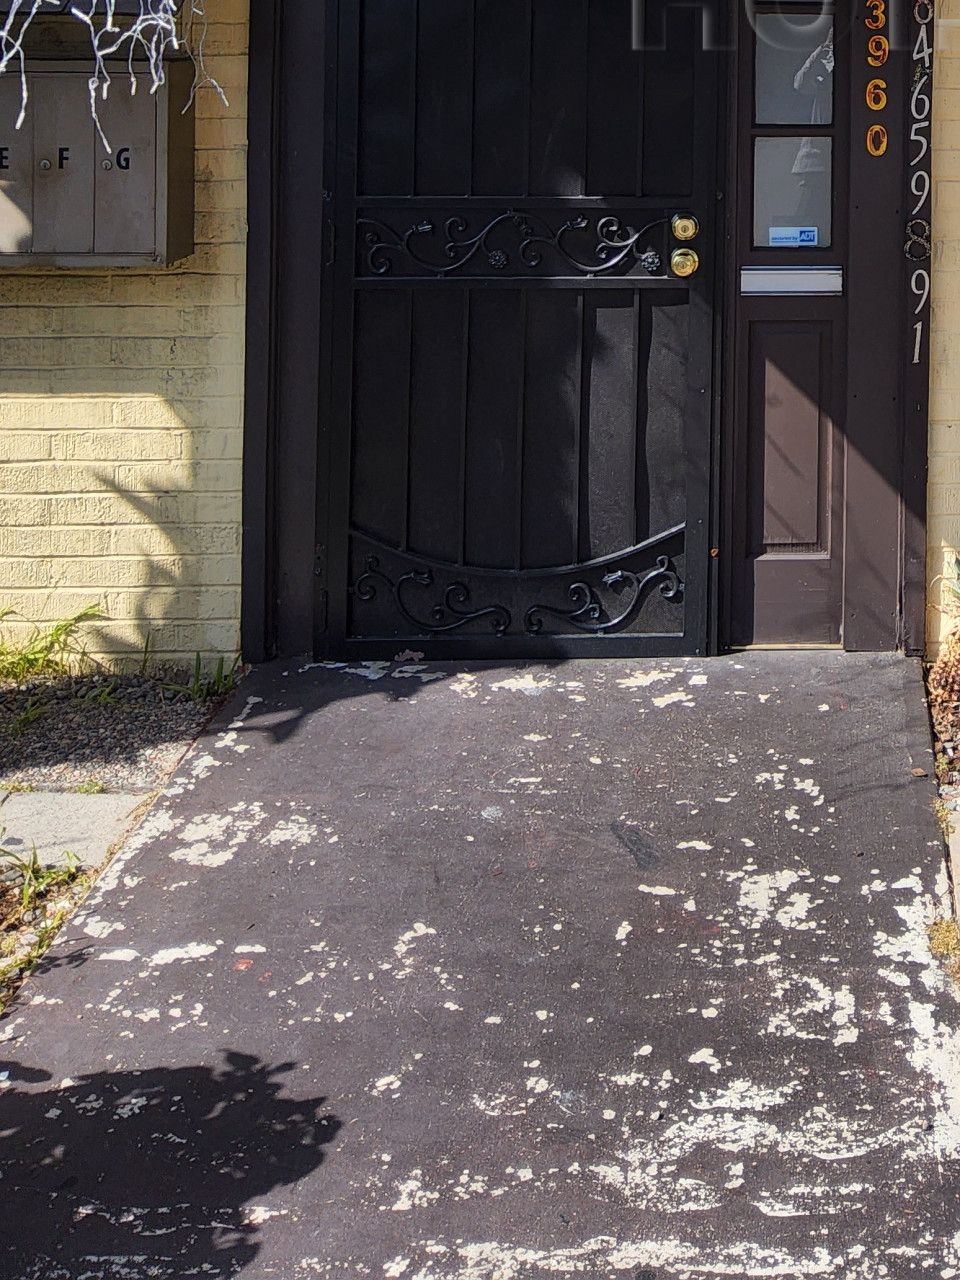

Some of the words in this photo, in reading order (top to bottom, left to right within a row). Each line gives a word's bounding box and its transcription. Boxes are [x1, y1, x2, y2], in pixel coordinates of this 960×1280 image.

[58, 147, 70, 170] F
[115, 147, 131, 171] G
[800, 231, 815, 241] ADT
